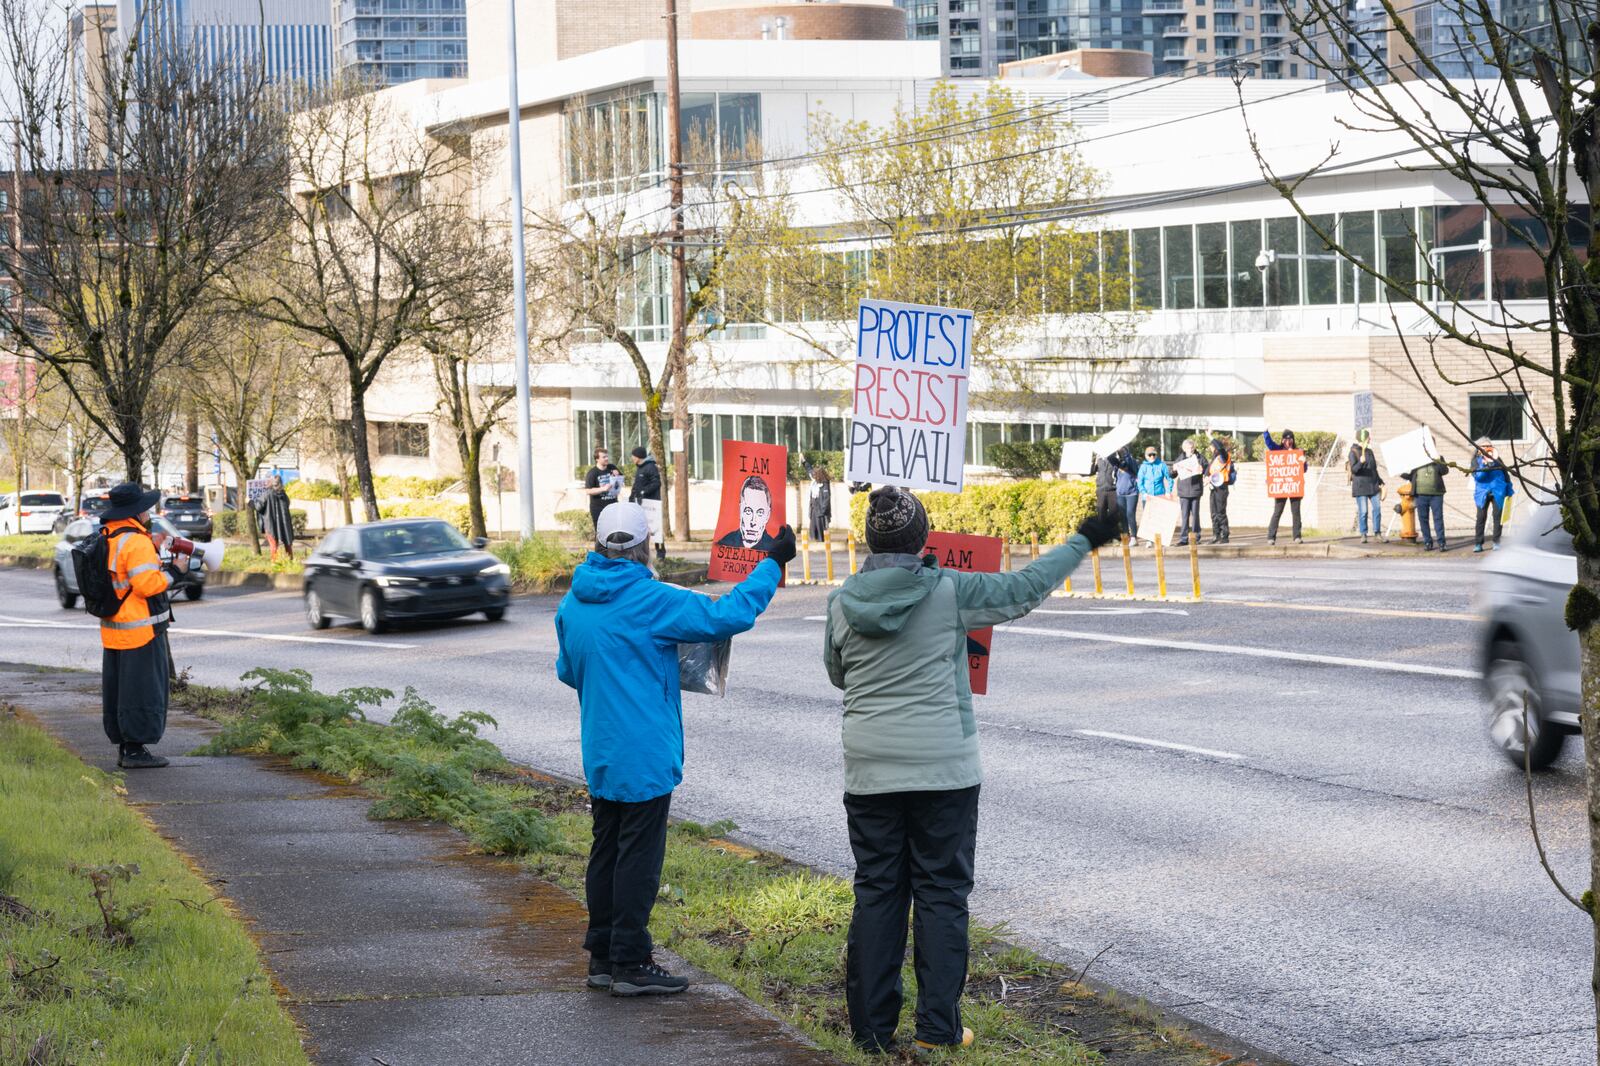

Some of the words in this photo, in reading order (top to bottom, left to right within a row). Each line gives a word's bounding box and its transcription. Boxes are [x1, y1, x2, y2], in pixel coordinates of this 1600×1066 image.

[858, 305, 972, 369] PROTEST
[853, 363, 967, 427] RESIST
[849, 421, 958, 486] PREVAIL
[1269, 454, 1286, 466] SAVE
[1286, 453, 1300, 466] OUR
[739, 455, 747, 472] I
[751, 457, 770, 475] AM
[1269, 466, 1300, 477] DEMOCRACY
[722, 561, 748, 575] FROM
[943, 549, 974, 569] AM
